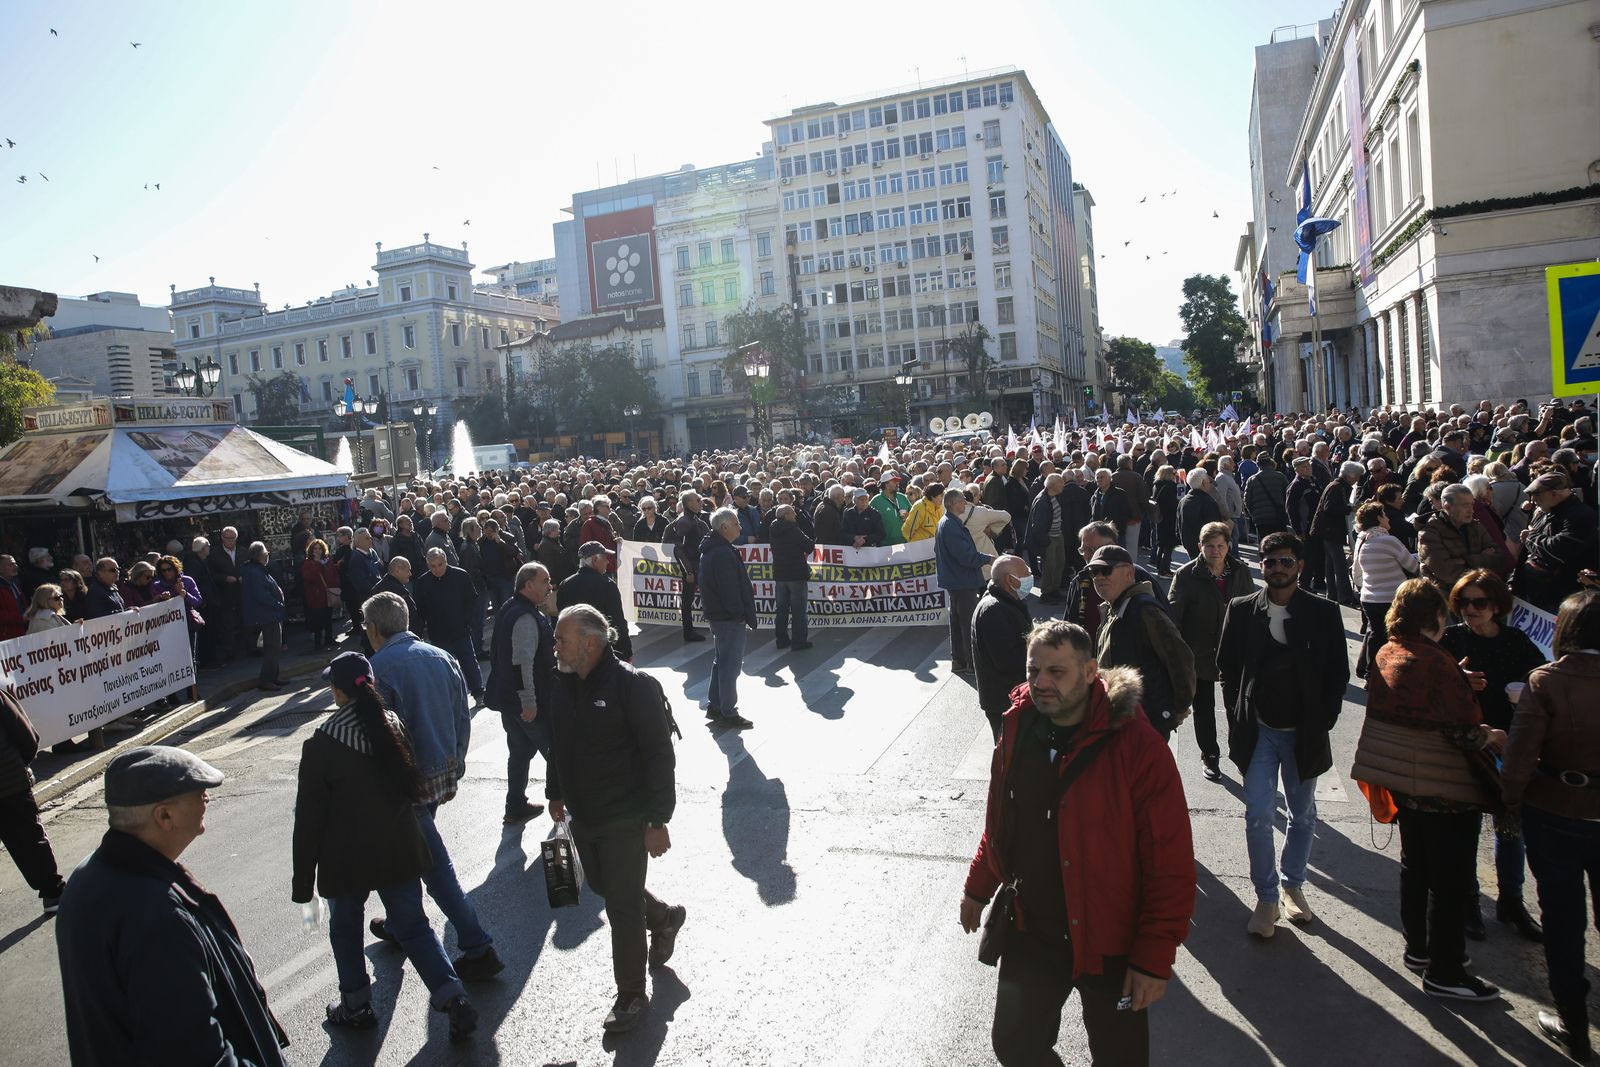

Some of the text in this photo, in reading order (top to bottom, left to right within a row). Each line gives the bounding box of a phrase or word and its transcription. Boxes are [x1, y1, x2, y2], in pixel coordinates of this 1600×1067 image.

[850, 560, 936, 581] ΣΥΝΤΑΞΕΙΣ
[645, 577, 665, 591] ΝΑ
[850, 578, 928, 598] ΣΥΝΤΑΞΗ
[637, 593, 654, 606] ΝΑ
[806, 595, 909, 615] ΑΠΟΘΕΜΑΤΙΚΑ
[911, 593, 942, 610] ΜΑΣ
[638, 610, 677, 622] ΣΩΜΑΤΕΙΟ
[832, 615, 847, 625] ΙΚΑ
[850, 611, 941, 624] ΑΘΗΝΑΣ-ΓΑΛΑΤΣΙΟΥ
[1, 609, 184, 678] μας ποτάμι, της οργής, όταν φουσκώσει,
[6, 640, 160, 701] Κανένας δεν μπορεί να ανακόψει
[104, 663, 164, 693] Πανελλήνια Ένωση
[68, 698, 120, 726] Συνταξιούχων
[122, 679, 167, 704] Εκπαιδευτικών
